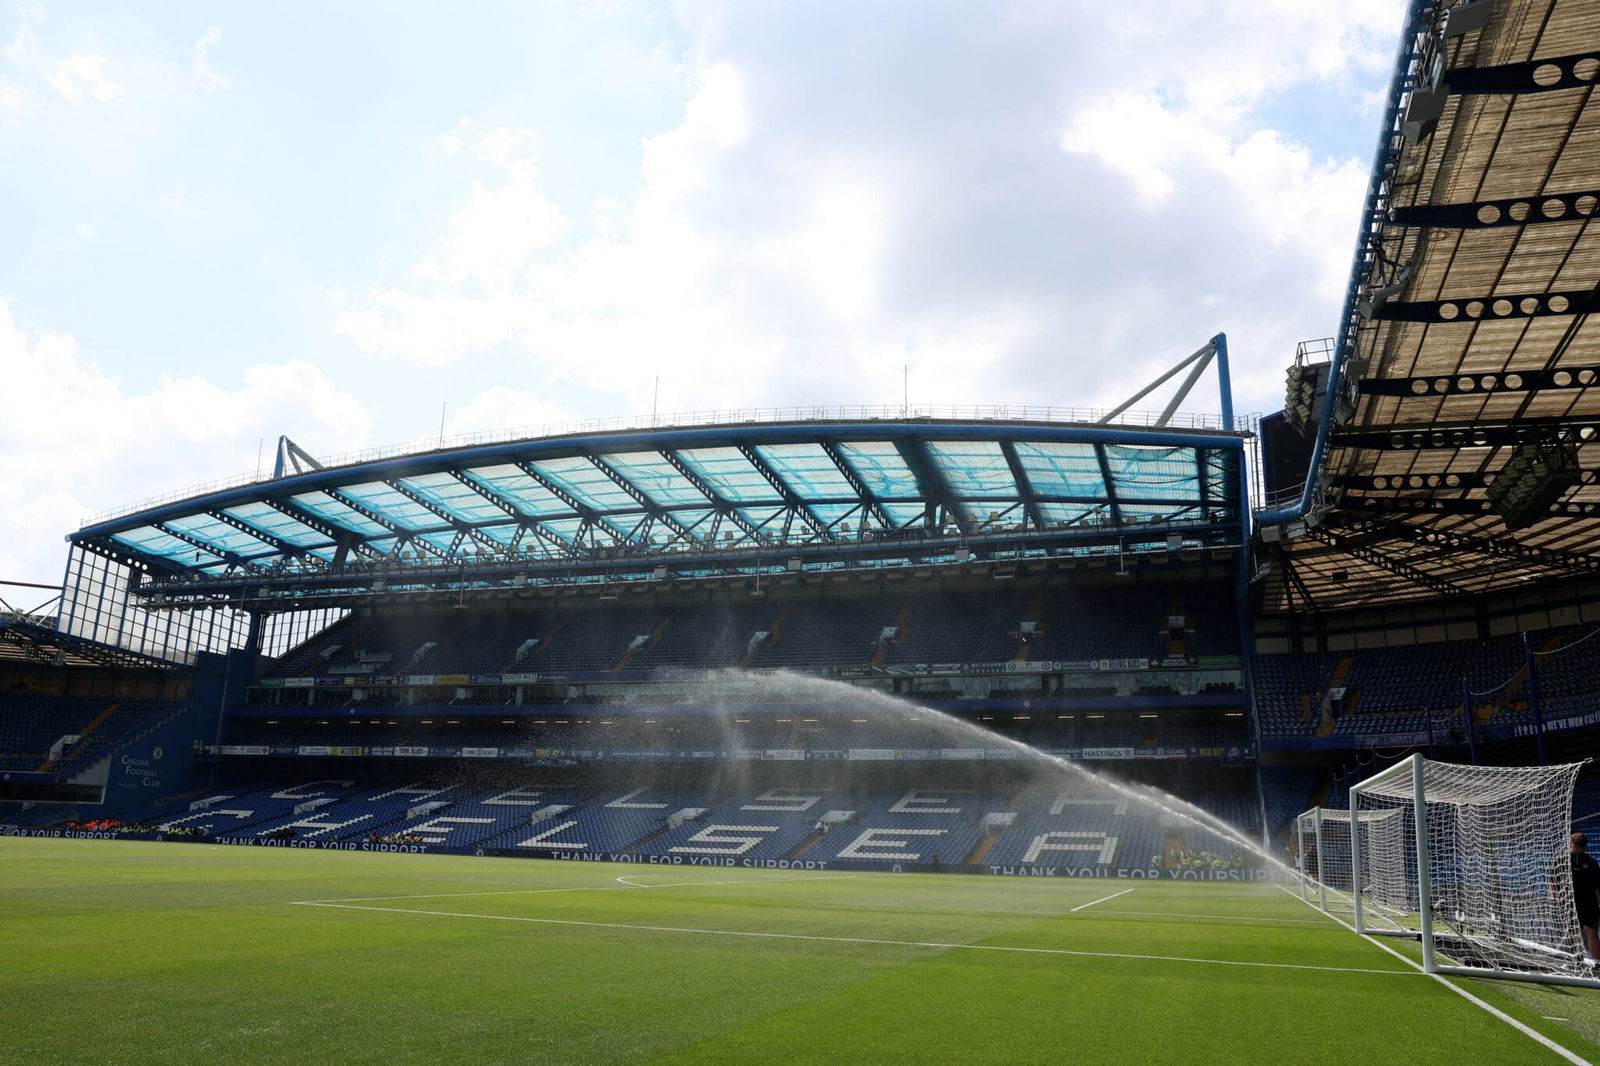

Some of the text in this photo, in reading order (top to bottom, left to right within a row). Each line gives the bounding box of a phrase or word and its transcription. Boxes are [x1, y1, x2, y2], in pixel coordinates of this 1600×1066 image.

[121, 754, 149, 767] CHELSEA
[1084, 750, 1122, 758] HASTINGS
[125, 765, 158, 777] FOOTBALL
[215, 836, 427, 853] THANK YOU FOR YOUR SUPPORT
[551, 851, 827, 868] THANK YOU FOR YOUR SUPPORT
[990, 865, 1054, 876] THANK
[1068, 867, 1108, 878] YOU
[1117, 869, 1160, 878] FOR
